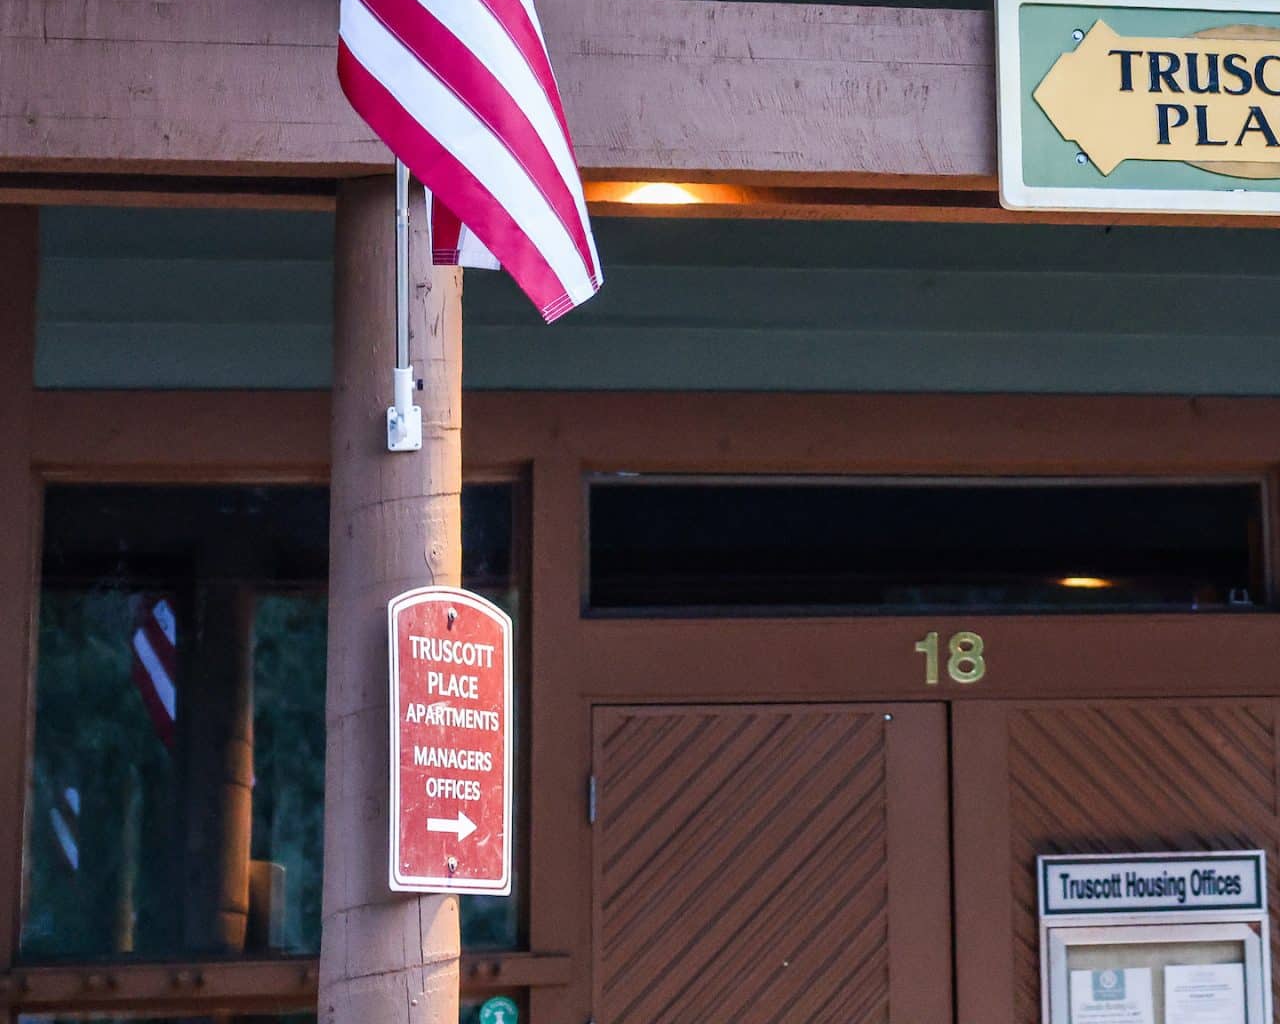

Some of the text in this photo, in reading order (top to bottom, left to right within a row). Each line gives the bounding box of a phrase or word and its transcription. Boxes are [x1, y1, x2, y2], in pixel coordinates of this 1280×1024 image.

[409, 635, 495, 668] TRUSCOTT
[915, 631, 986, 684] 18
[427, 671, 479, 699] PLACE
[405, 703, 499, 732] APARTMENTS
[413, 745, 492, 772] MANAGERS
[426, 777, 480, 801] OFFICES
[1060, 869, 1242, 903] Truscott Housing Offices
